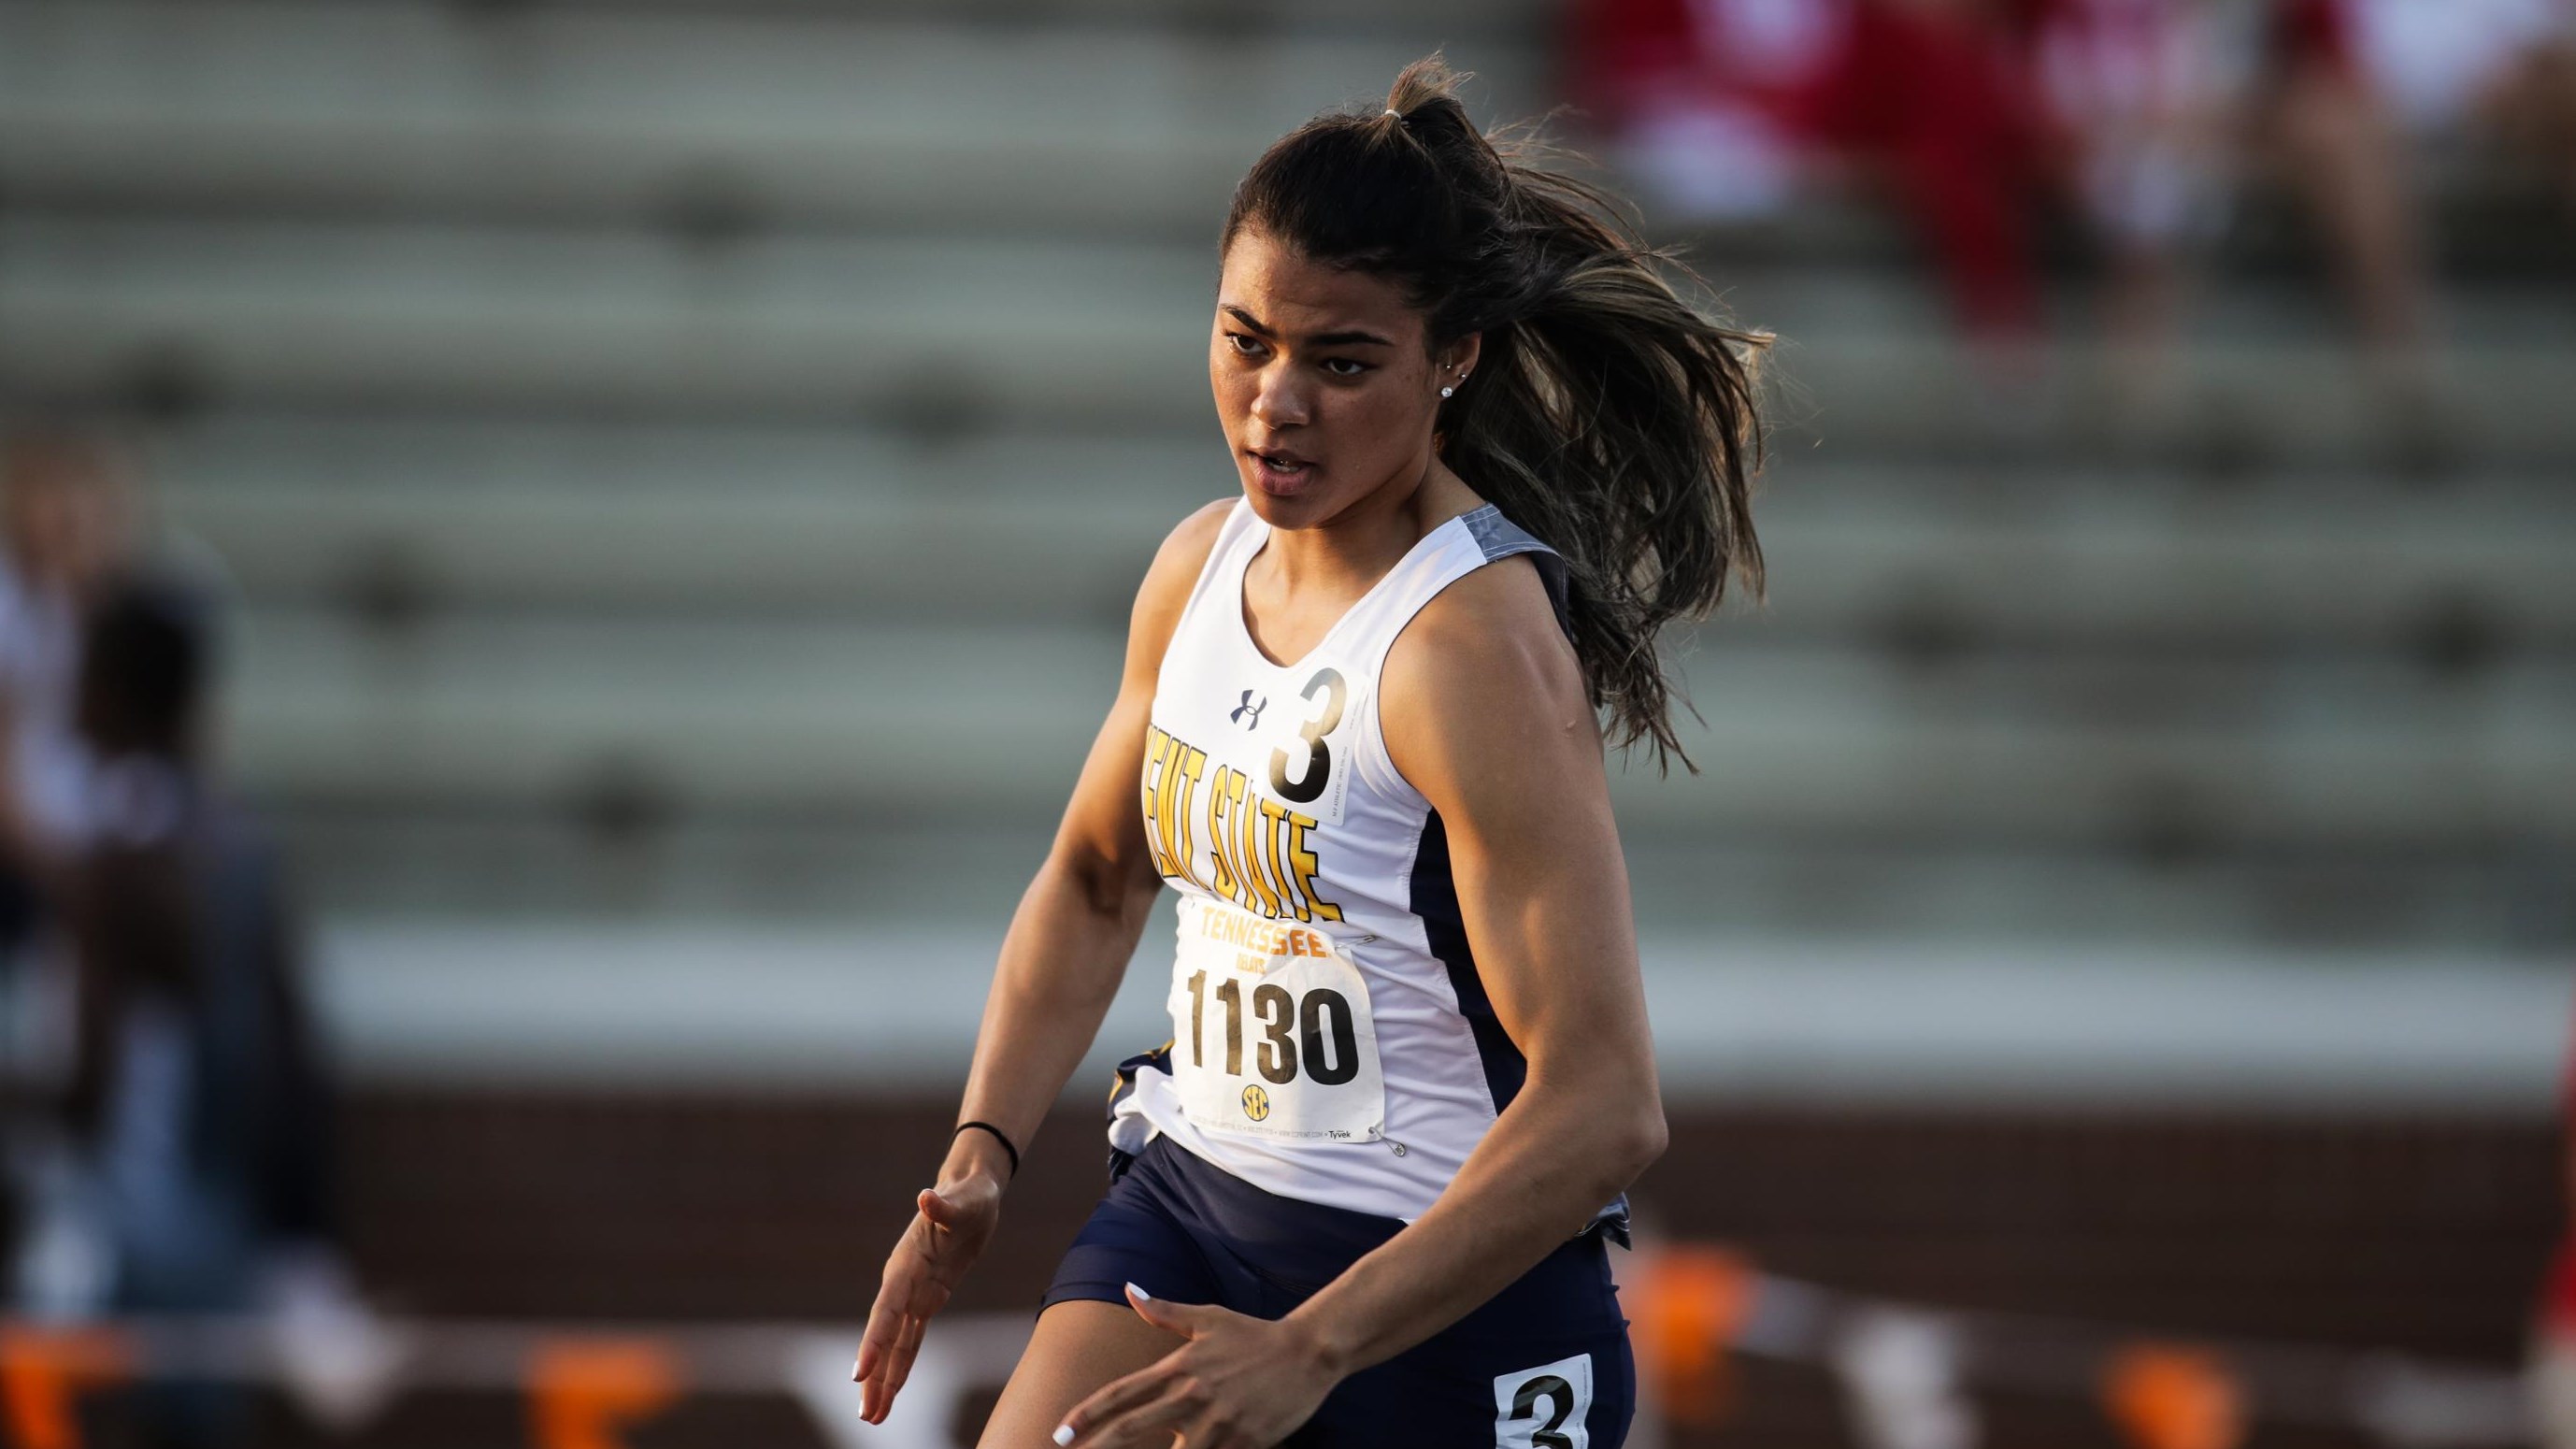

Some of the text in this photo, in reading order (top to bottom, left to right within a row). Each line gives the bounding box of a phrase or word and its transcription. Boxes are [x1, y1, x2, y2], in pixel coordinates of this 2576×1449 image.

[1268, 667, 1347, 803] 3
[1141, 723, 1346, 924] ENT STATE
[1201, 907, 1327, 958] TENNESSEE
[1187, 968, 1359, 1085] 1130
[1243, 1085, 1268, 1120] SEC
[1328, 1130, 1352, 1140] Tyvek
